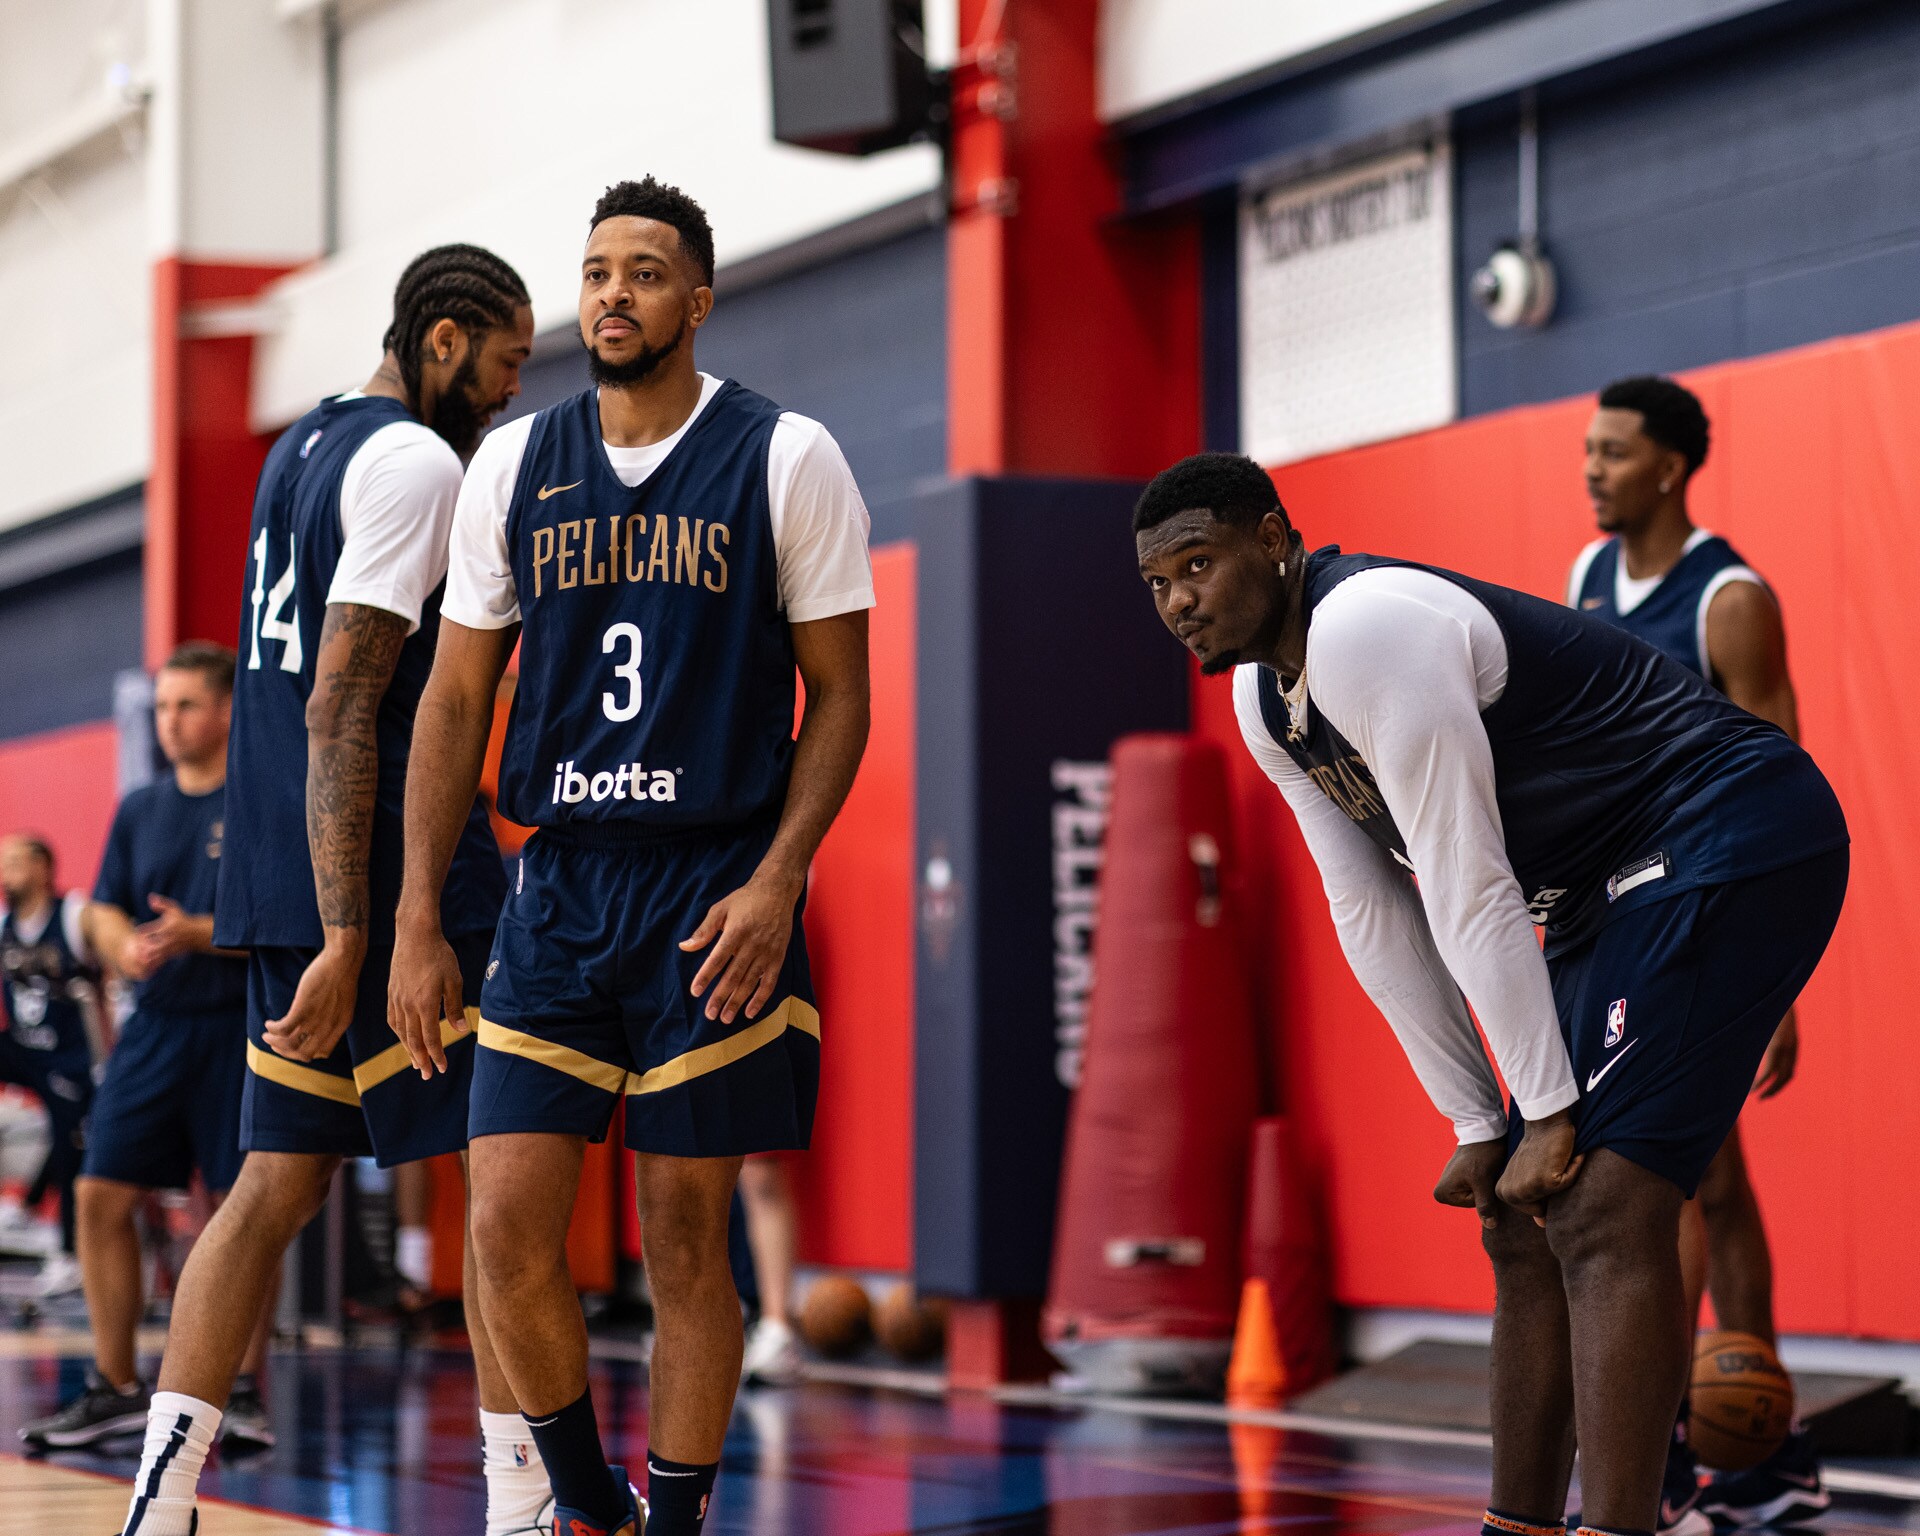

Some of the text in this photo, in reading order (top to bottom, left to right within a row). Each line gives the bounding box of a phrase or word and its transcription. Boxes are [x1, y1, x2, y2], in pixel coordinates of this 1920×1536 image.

[248, 527, 303, 674] 14
[532, 513, 731, 599] PELICANS
[602, 622, 642, 722] 3
[552, 760, 677, 805] ibotta
